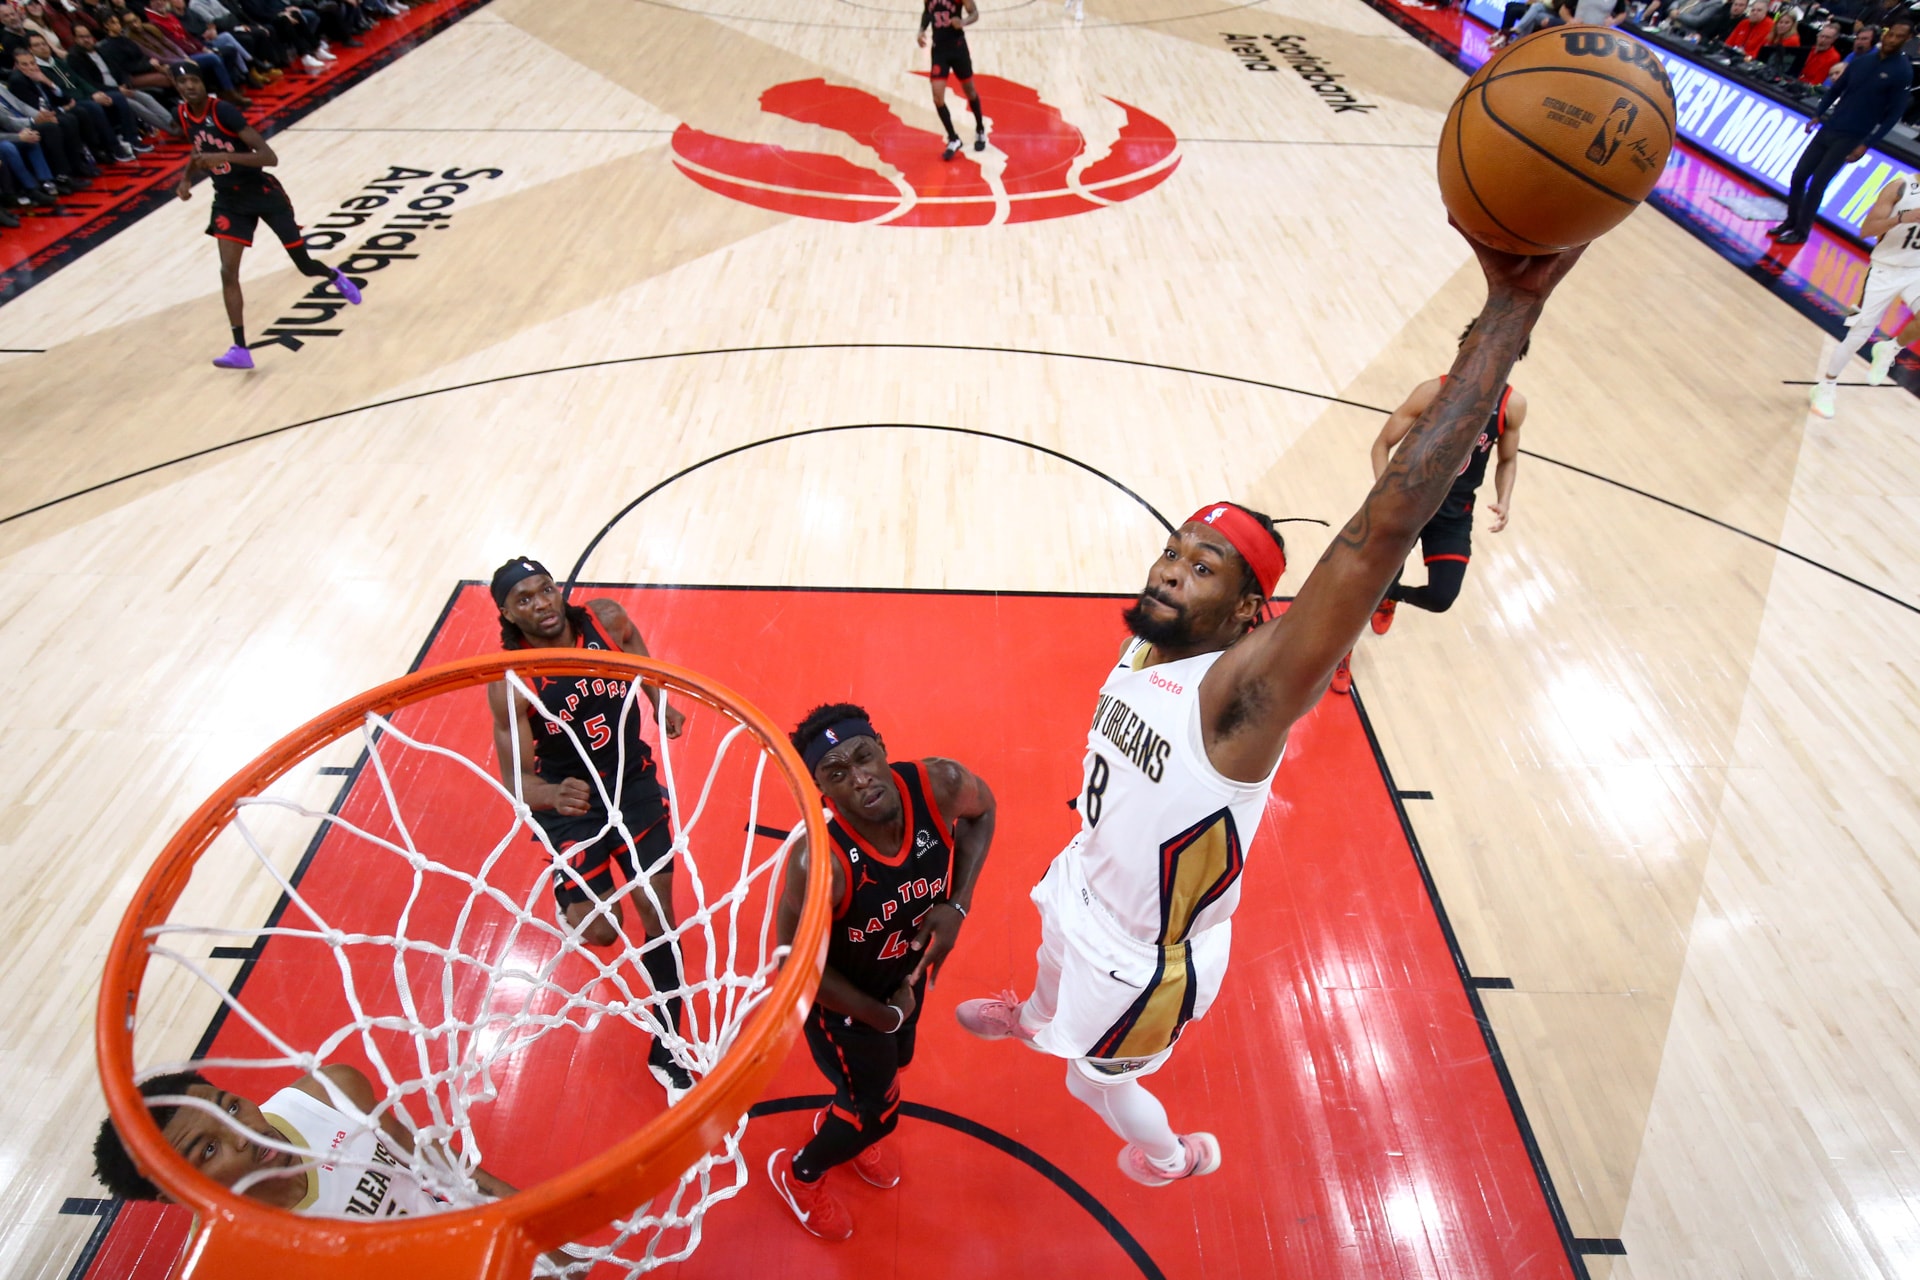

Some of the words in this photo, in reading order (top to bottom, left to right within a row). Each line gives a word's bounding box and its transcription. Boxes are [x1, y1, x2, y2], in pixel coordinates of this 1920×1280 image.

[1219, 32, 1280, 72] Arena
[1263, 34, 1378, 113] Scotiabank
[303, 166, 433, 250] Arena
[248, 167, 503, 352] Scotiabank
[545, 678, 627, 735] RAPTORS
[1149, 671, 1184, 696] ibotta
[583, 713, 612, 751] 5
[1101, 698, 1171, 784] ORLEANS
[1086, 751, 1109, 829] 8
[849, 847, 860, 863] 6
[848, 871, 949, 943] RAPTOR
